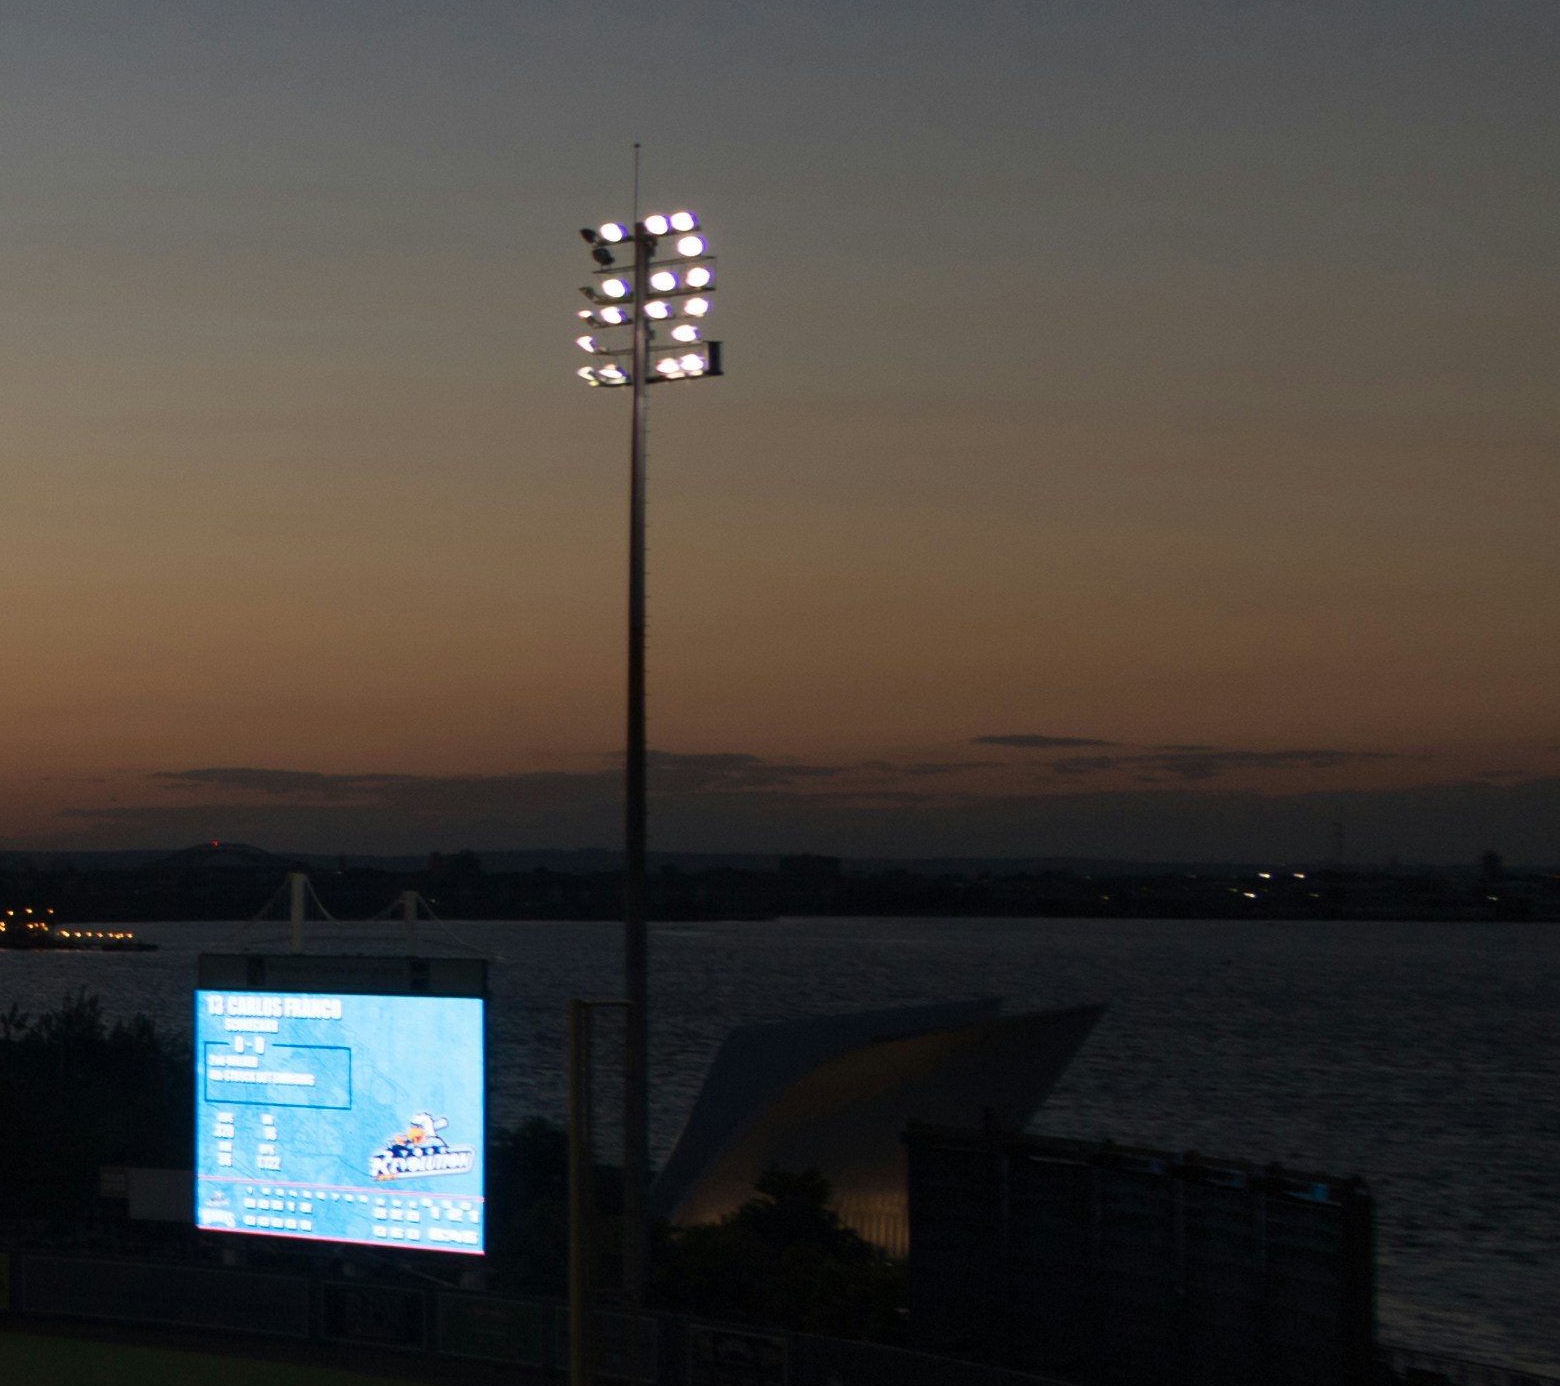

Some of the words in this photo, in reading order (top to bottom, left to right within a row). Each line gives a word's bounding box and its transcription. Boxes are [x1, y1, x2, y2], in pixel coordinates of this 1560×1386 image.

[207, 995, 224, 1015] 13
[227, 996, 282, 1017] CARLOS
[283, 997, 342, 1020] FRANCO
